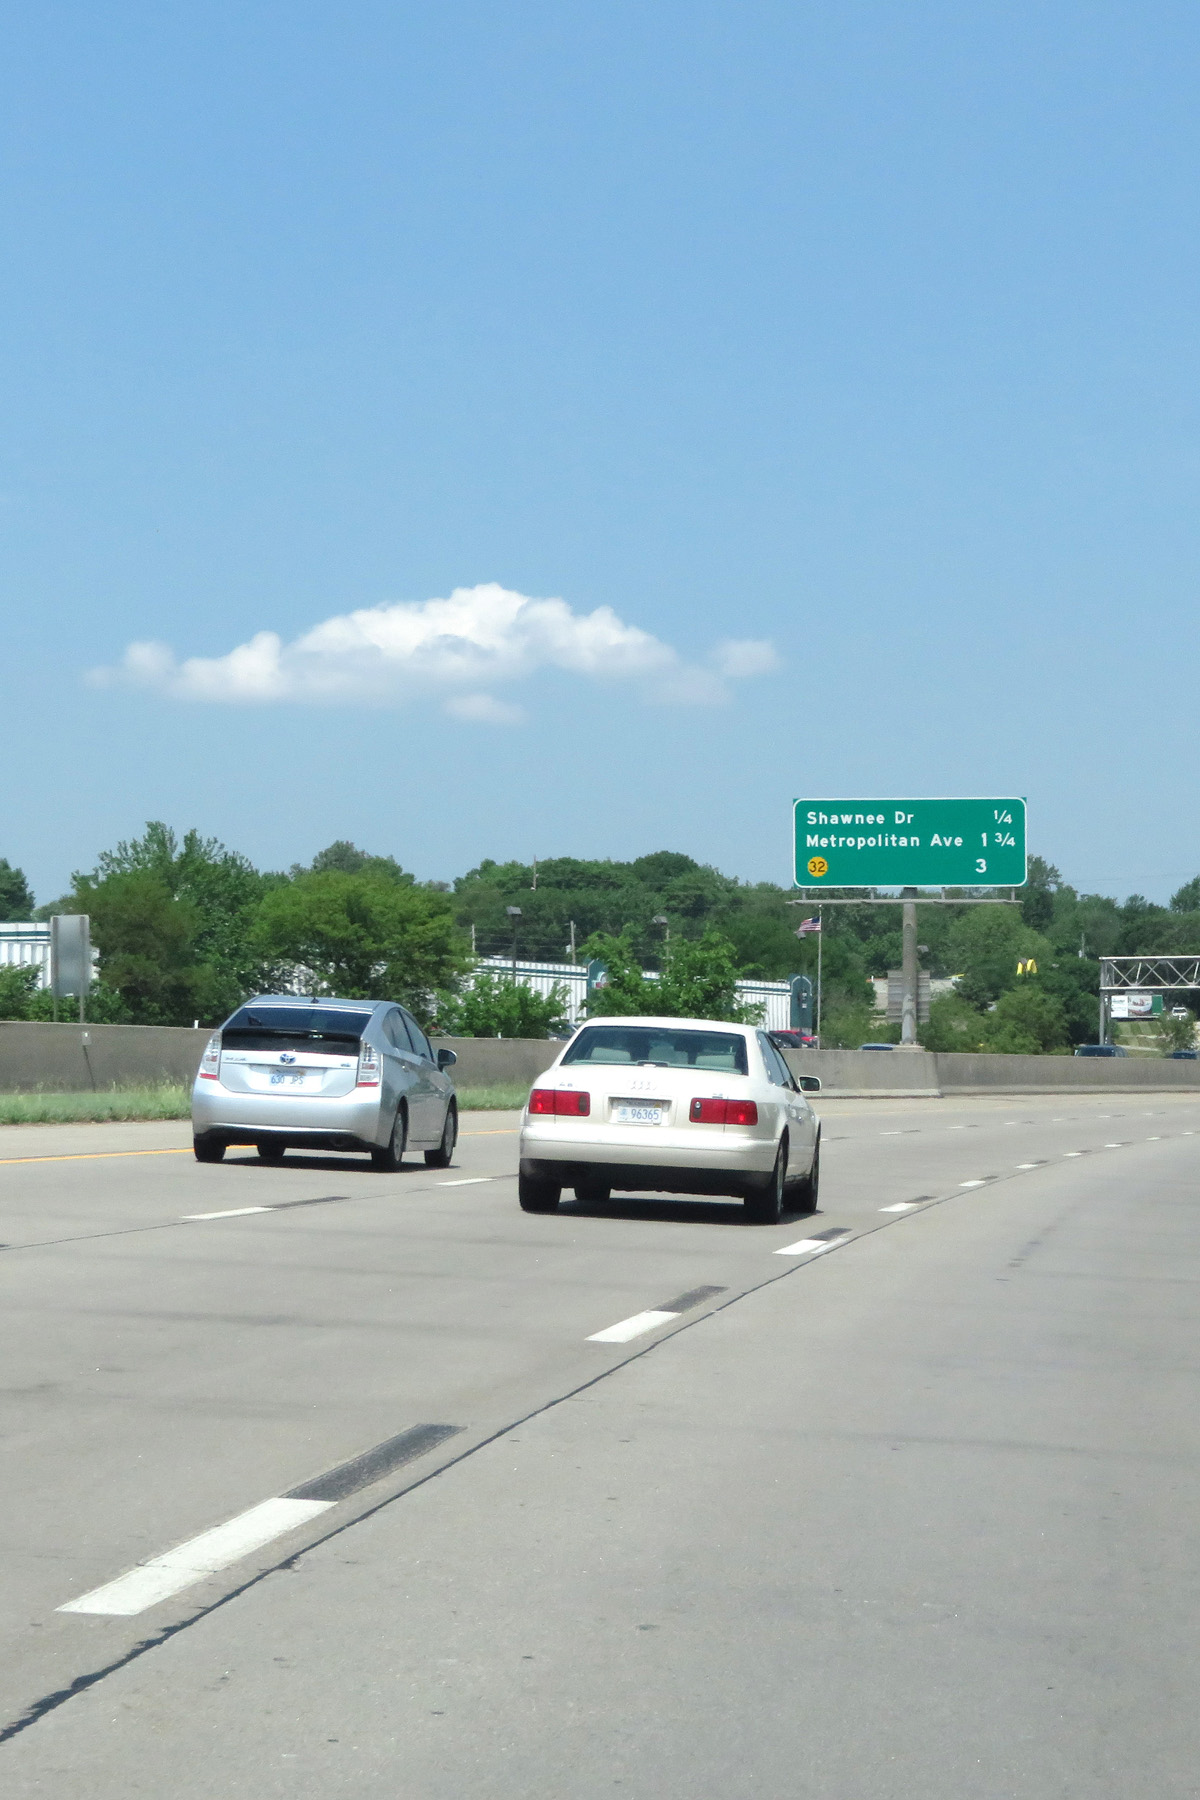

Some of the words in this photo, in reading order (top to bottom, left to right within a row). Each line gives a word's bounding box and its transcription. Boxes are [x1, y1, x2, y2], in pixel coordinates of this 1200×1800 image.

[806, 811, 885, 825] Shawnee
[894, 811, 915, 825] Dr
[806, 833, 920, 850] Metropolitan
[930, 833, 964, 847] Ave
[981, 832, 988, 847] 1
[808, 860, 826, 873] 32
[974, 858, 988, 874] 3
[631, 1108, 660, 1120] 96365
